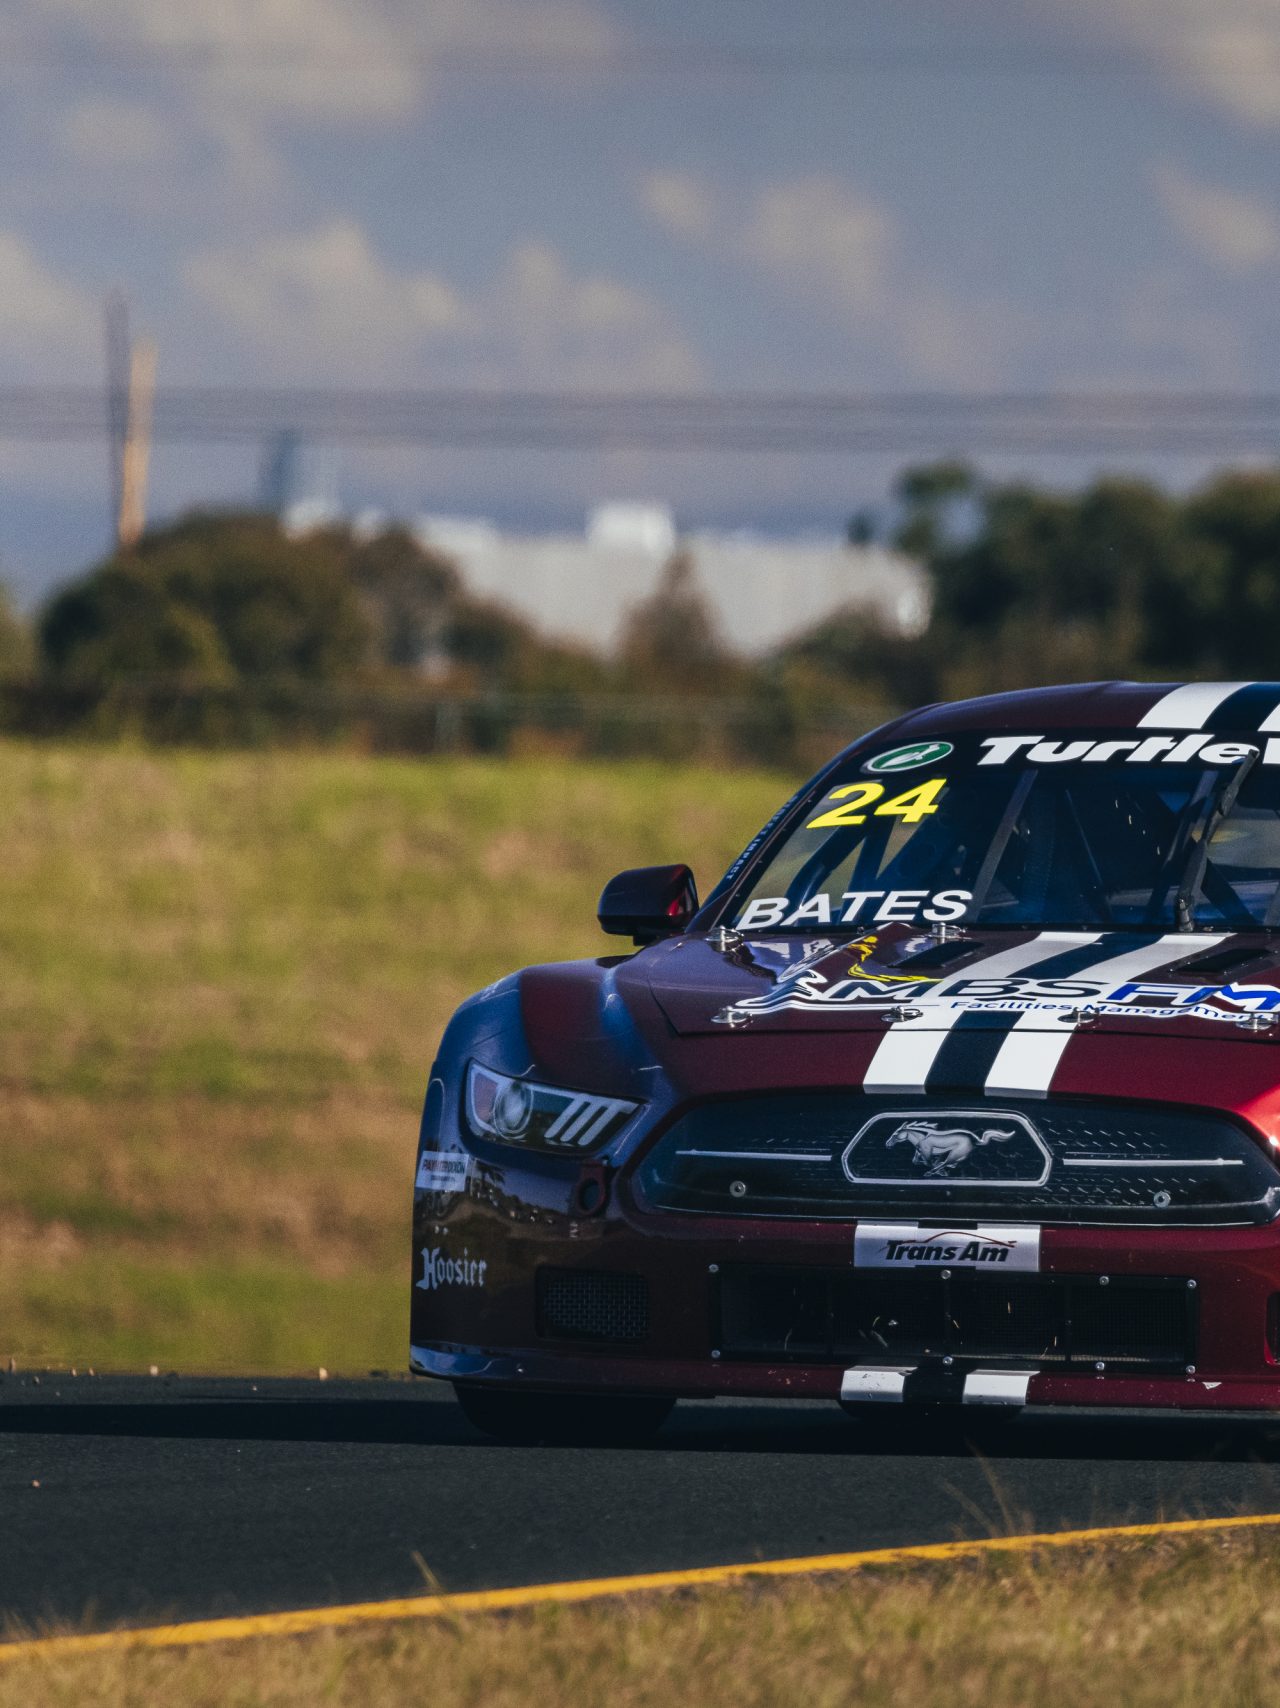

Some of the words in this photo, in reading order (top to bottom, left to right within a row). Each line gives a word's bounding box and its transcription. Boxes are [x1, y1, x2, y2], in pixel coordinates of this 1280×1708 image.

[806, 778, 947, 829] 24
[736, 889, 973, 930] BATES
[951, 1000, 1073, 1012] Facilities
[415, 1247, 488, 1291] Hoosier
